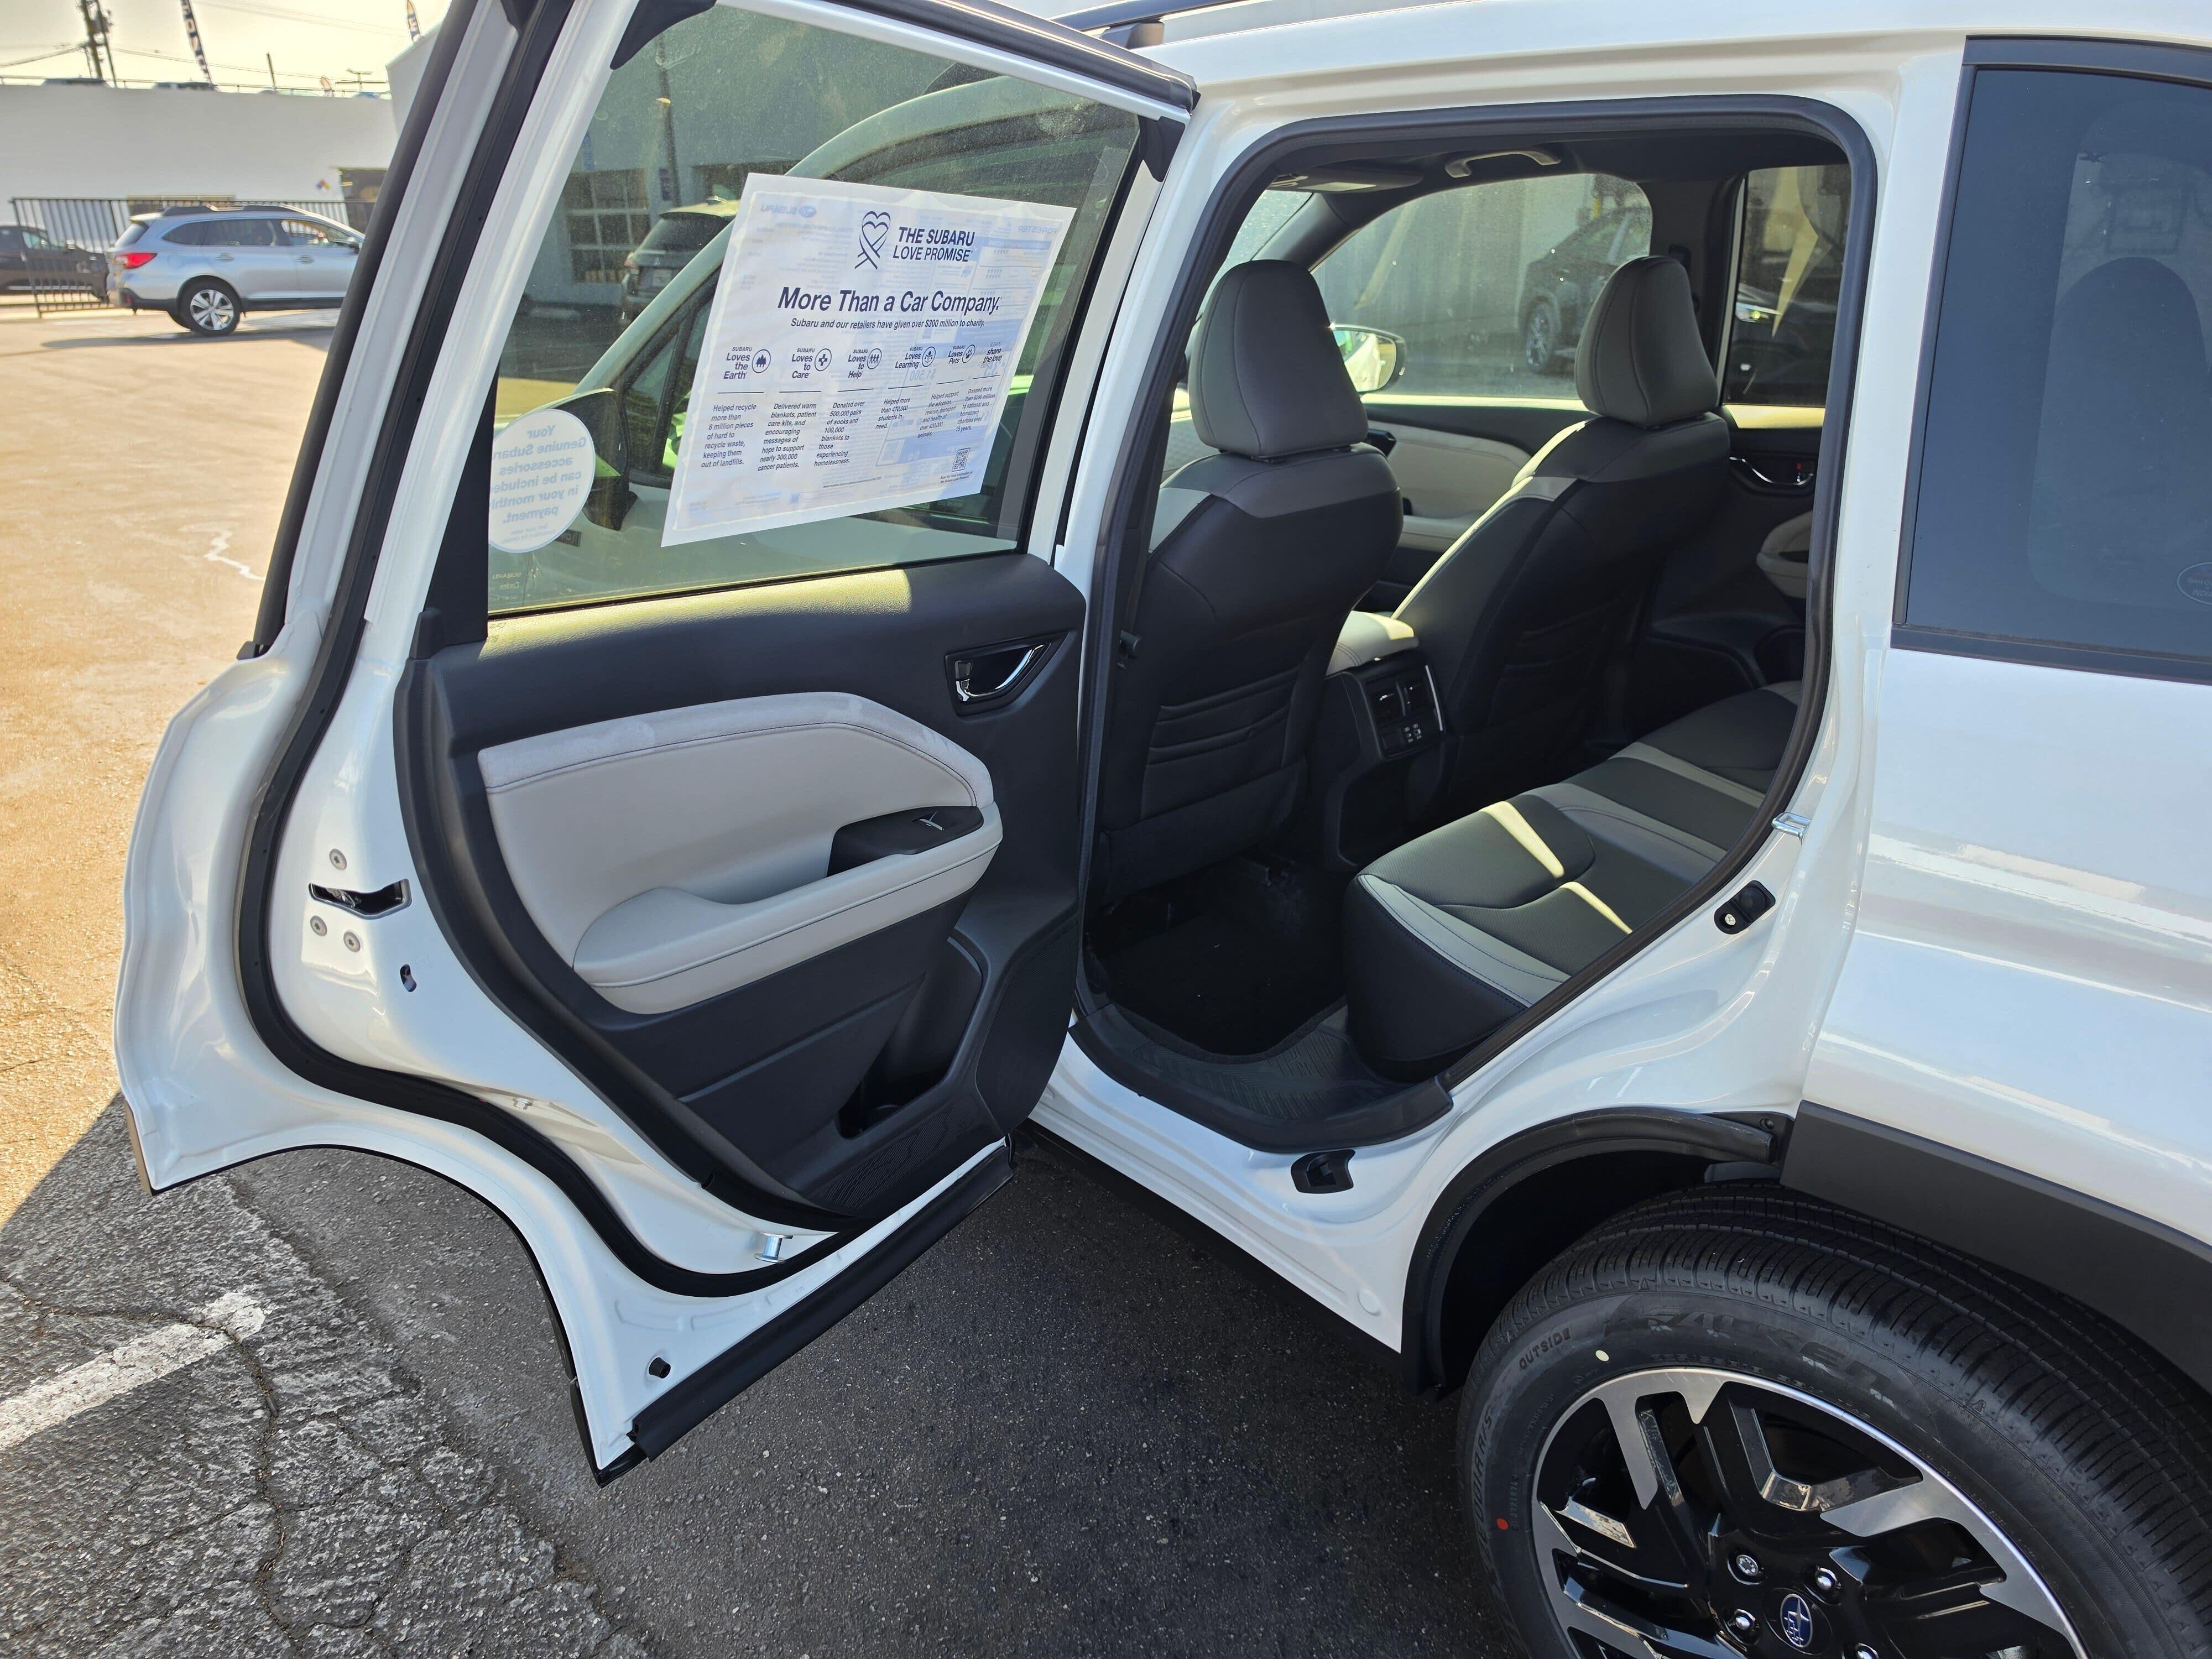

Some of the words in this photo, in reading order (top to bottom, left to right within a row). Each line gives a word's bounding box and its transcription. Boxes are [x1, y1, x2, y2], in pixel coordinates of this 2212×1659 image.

[899, 227, 925, 243] THE
[926, 229, 975, 246] SUBARU
[893, 246, 922, 260] LOVE
[778, 287, 832, 311] More
[839, 290, 879, 312] Than
[883, 295, 895, 312] a
[900, 291, 928, 312] Car
[791, 318, 818, 328] Subaru
[820, 320, 835, 328] and
[850, 320, 875, 329] retailers
[877, 320, 893, 328] have
[894, 320, 910, 330] given
[925, 319, 938, 328] $300
[940, 319, 958, 327] million
[726, 353, 750, 361] Loves
[723, 371, 745, 379] Earth
[1519, 1327, 1572, 1370] OUTSIDE
